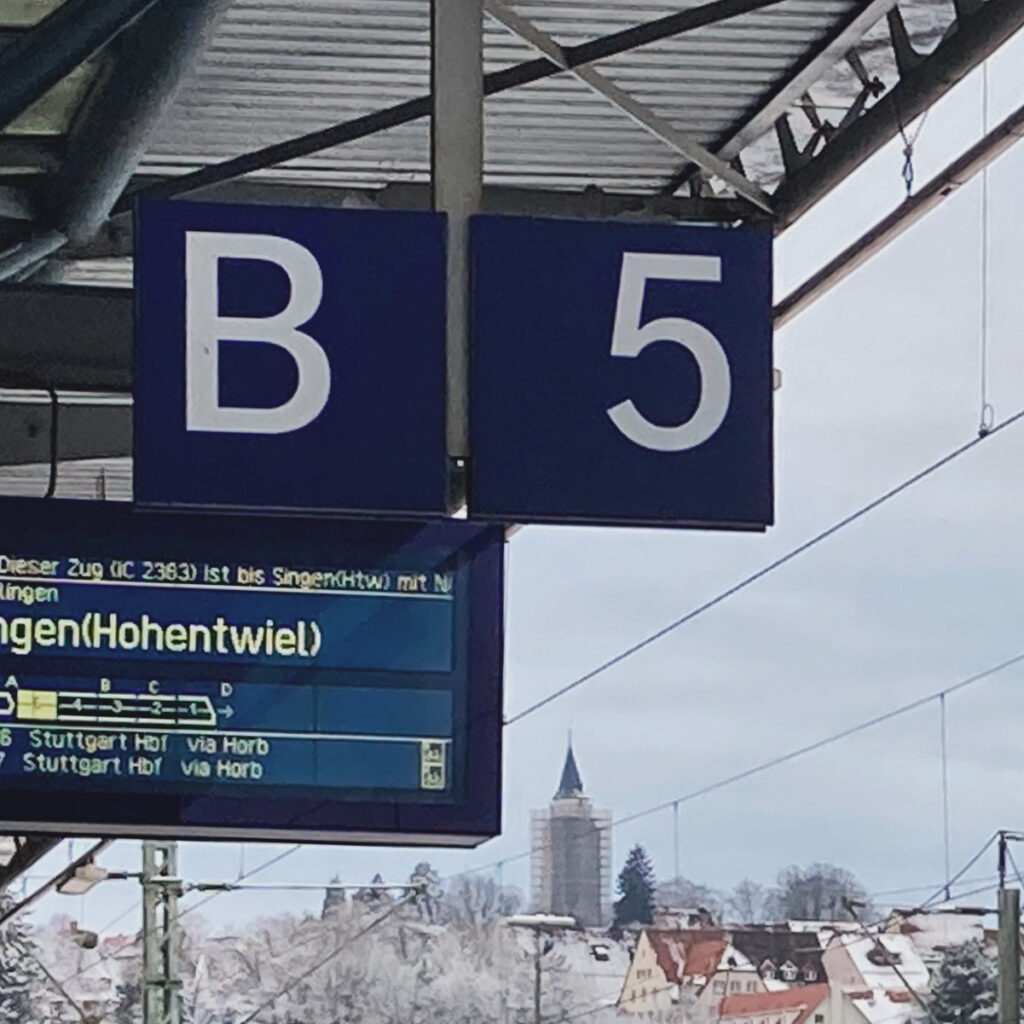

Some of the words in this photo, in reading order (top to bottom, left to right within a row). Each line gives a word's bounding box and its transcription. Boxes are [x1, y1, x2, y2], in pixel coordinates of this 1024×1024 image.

[185, 230, 332, 435] B
[606, 250, 732, 453] 5
[67, 557, 103, 581] Zug
[237, 566, 266, 585] bis
[397, 573, 428, 592] mit
[4, 674, 19, 689] A
[100, 678, 111, 692] B
[148, 680, 160, 694] C
[221, 682, 233, 697] D
[29, 729, 127, 754] Stuttgart
[186, 736, 216, 754] via
[222, 736, 269, 756] Horb
[23, 752, 121, 777] Stuttgart
[181, 759, 211, 778] via
[216, 760, 263, 780] Horb
